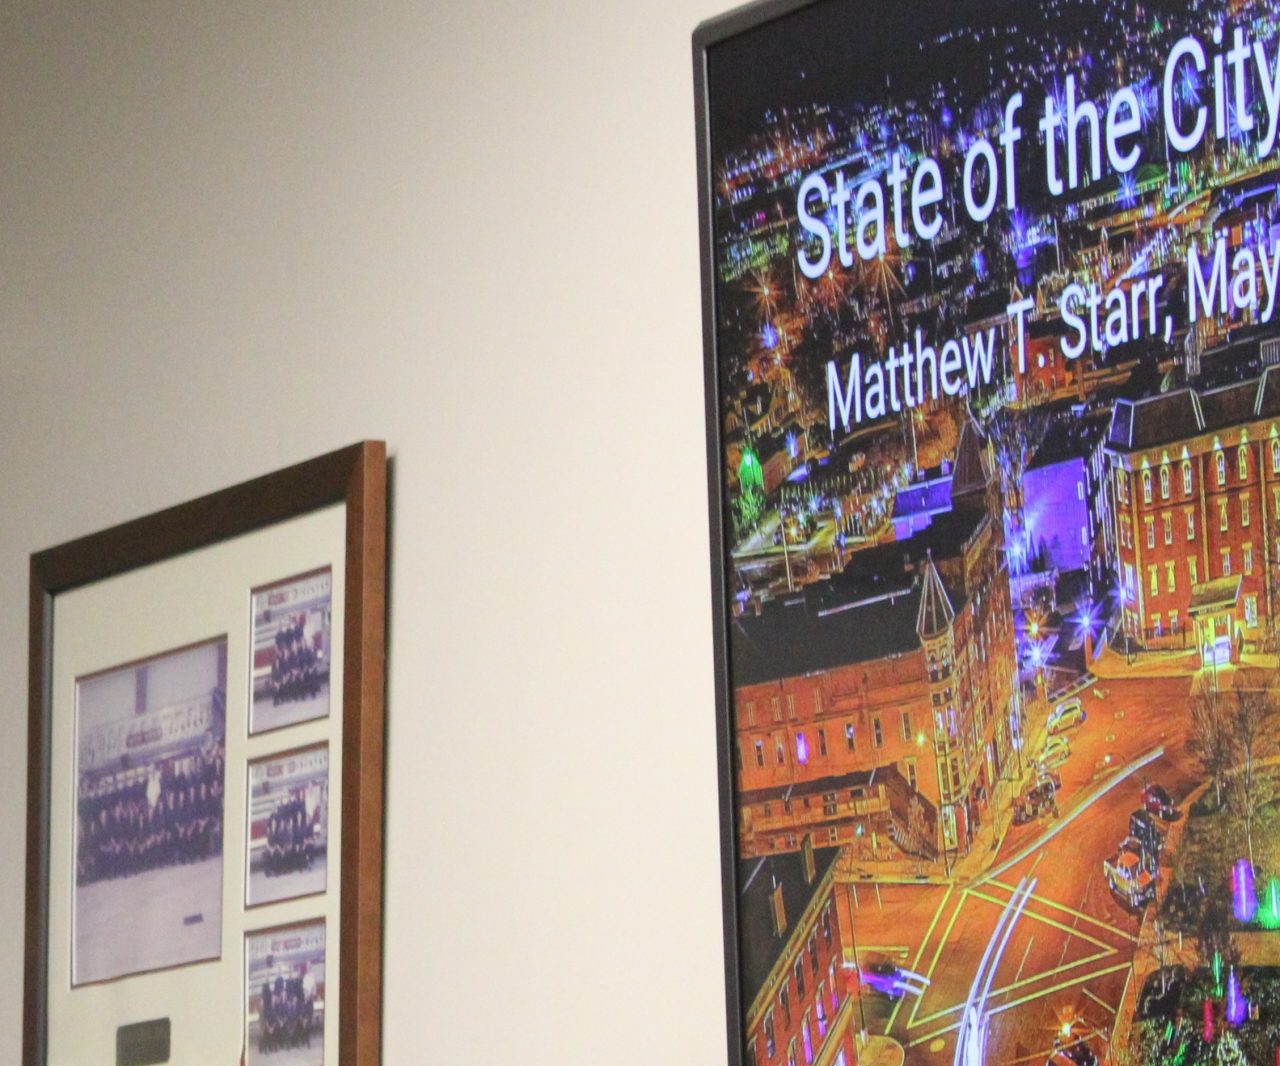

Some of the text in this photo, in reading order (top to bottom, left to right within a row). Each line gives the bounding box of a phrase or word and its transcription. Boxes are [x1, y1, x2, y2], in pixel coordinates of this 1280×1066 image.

[796, 25, 1280, 280] State of the City
[826, 327, 996, 431] Matthew
[1059, 275, 1174, 361] Starr,
